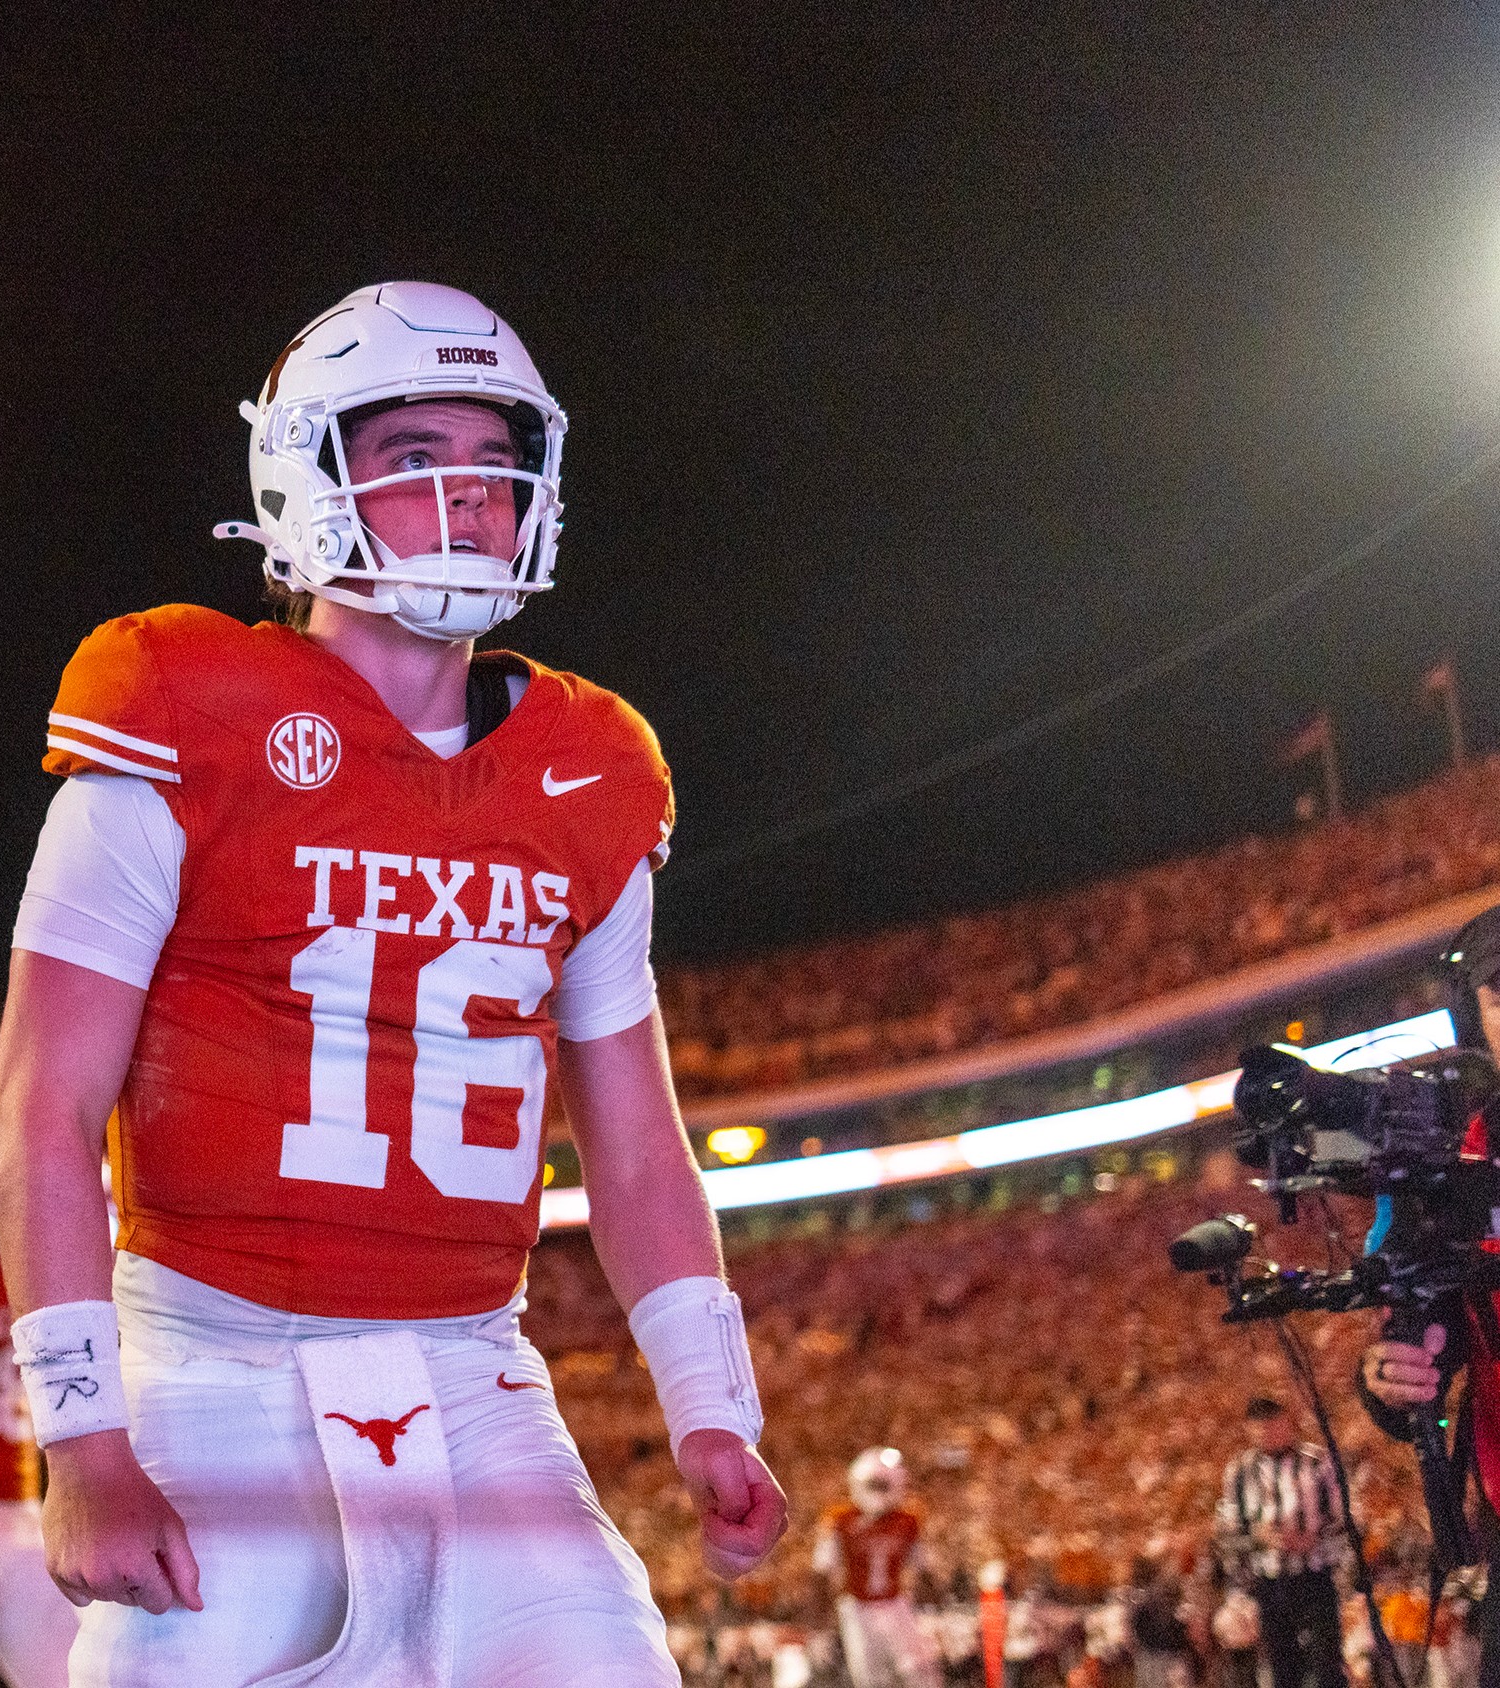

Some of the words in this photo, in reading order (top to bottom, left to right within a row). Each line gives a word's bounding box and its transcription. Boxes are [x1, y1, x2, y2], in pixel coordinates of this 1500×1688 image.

[436, 347, 498, 367] HORNS
[274, 718, 334, 784] SEC
[295, 846, 570, 943] TEXAS
[279, 926, 553, 1204] 16
